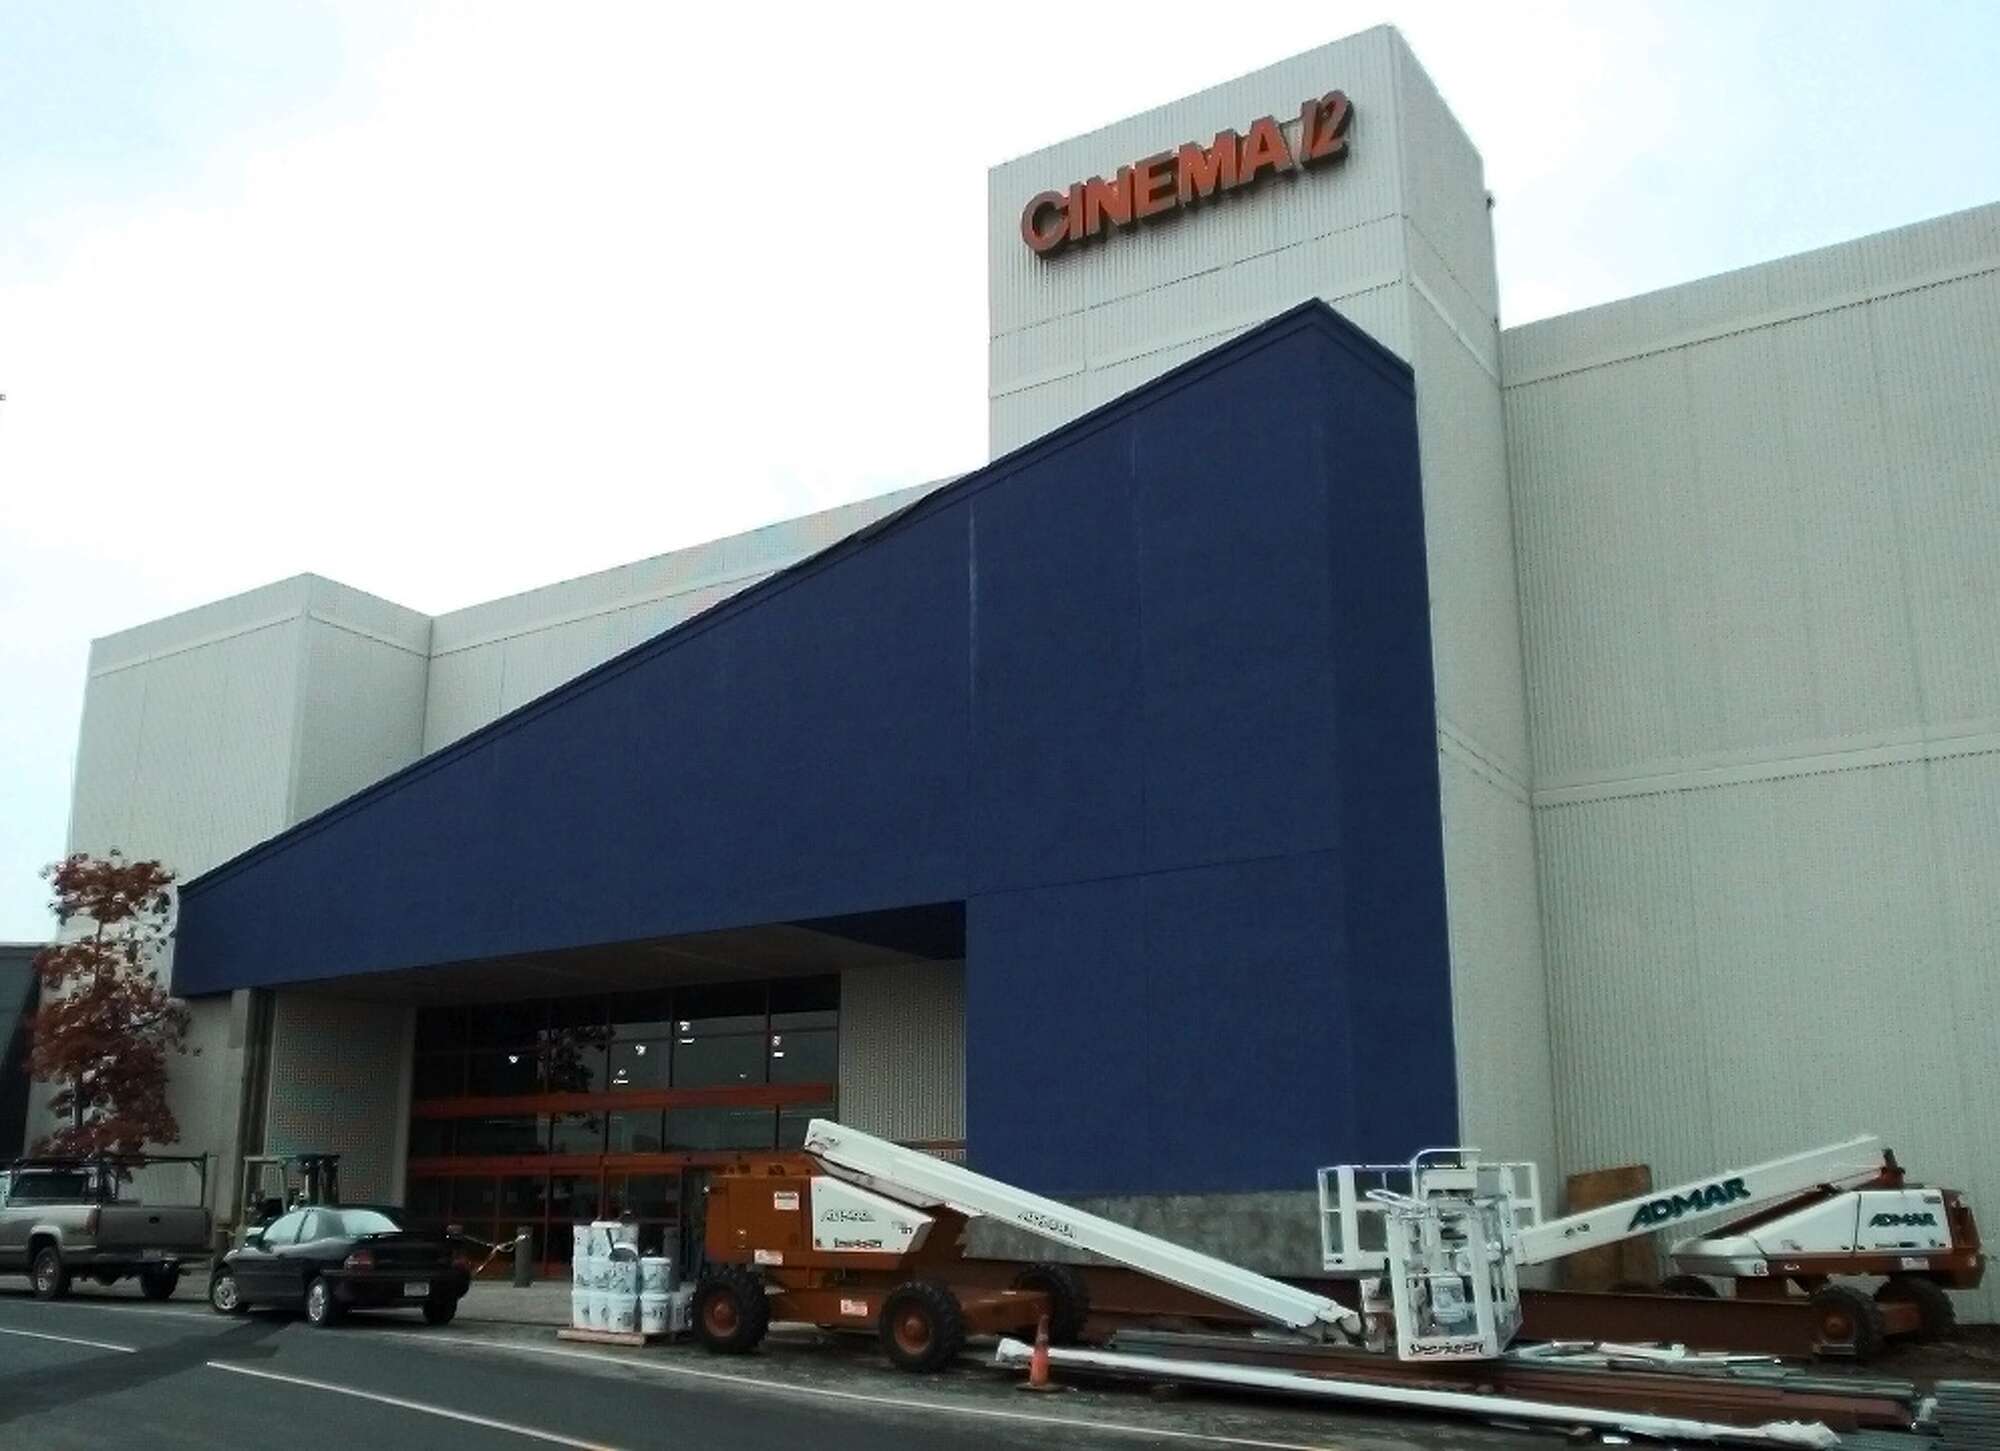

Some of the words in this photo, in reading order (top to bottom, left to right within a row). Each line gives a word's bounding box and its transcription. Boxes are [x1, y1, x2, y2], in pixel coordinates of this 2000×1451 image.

[1020, 114, 1294, 252] CINEMA
[1299, 88, 1353, 162] 12
[1628, 1177, 1750, 1232] ADMAR
[1869, 1212, 1937, 1228] ADMAR
